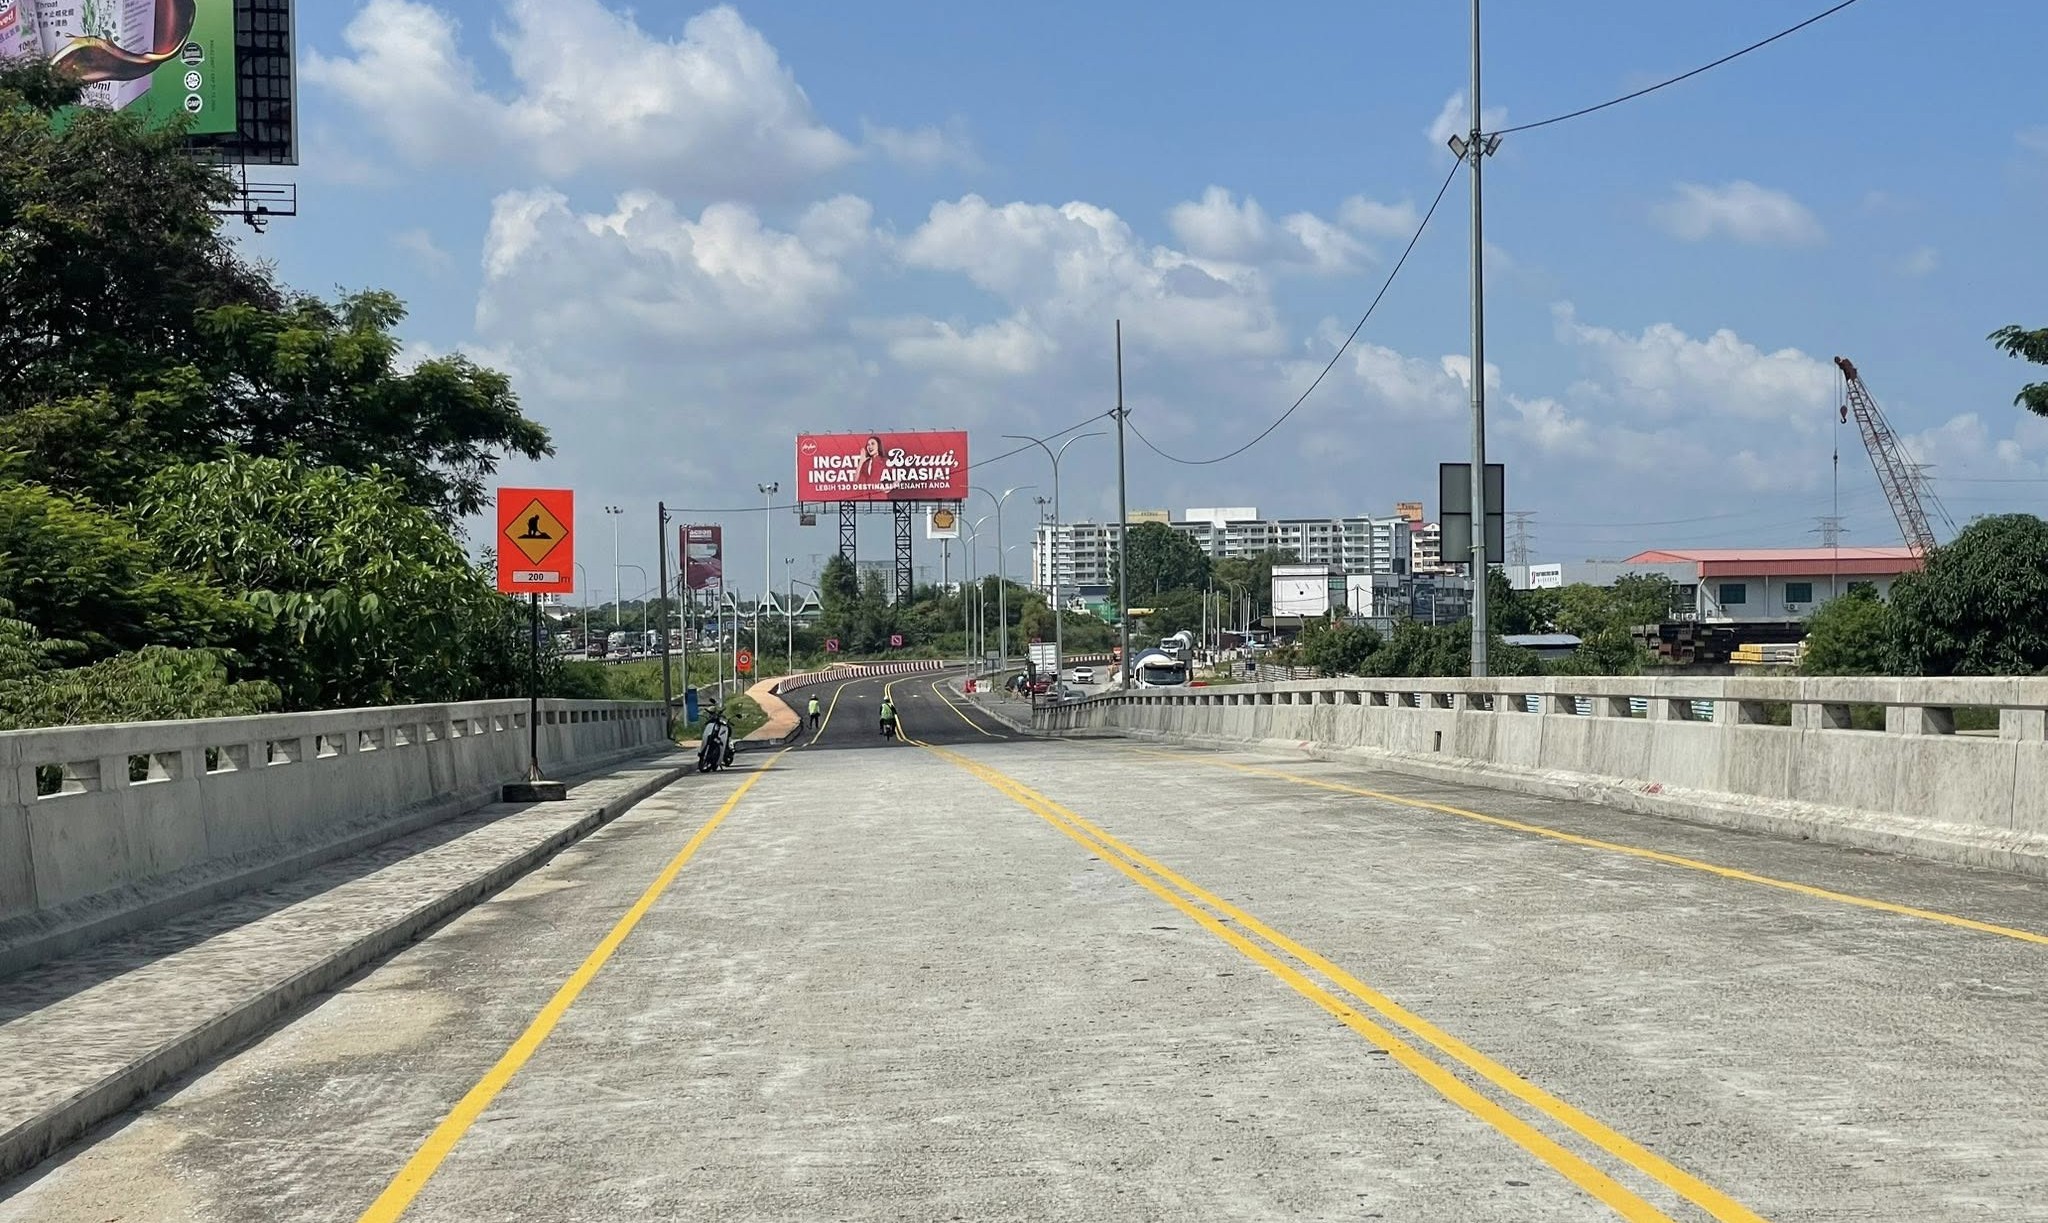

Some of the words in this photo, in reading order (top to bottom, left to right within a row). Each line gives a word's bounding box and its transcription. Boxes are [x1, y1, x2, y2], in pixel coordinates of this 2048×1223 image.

[813, 455, 860, 468] INGAT
[886, 448, 958, 467] Bercuti,
[808, 469, 857, 483] INGAT
[880, 467, 950, 482] AIRASIA!
[815, 484, 837, 492] LEBIH
[852, 482, 893, 491] DESTINASI
[528, 573, 544, 581] 200
